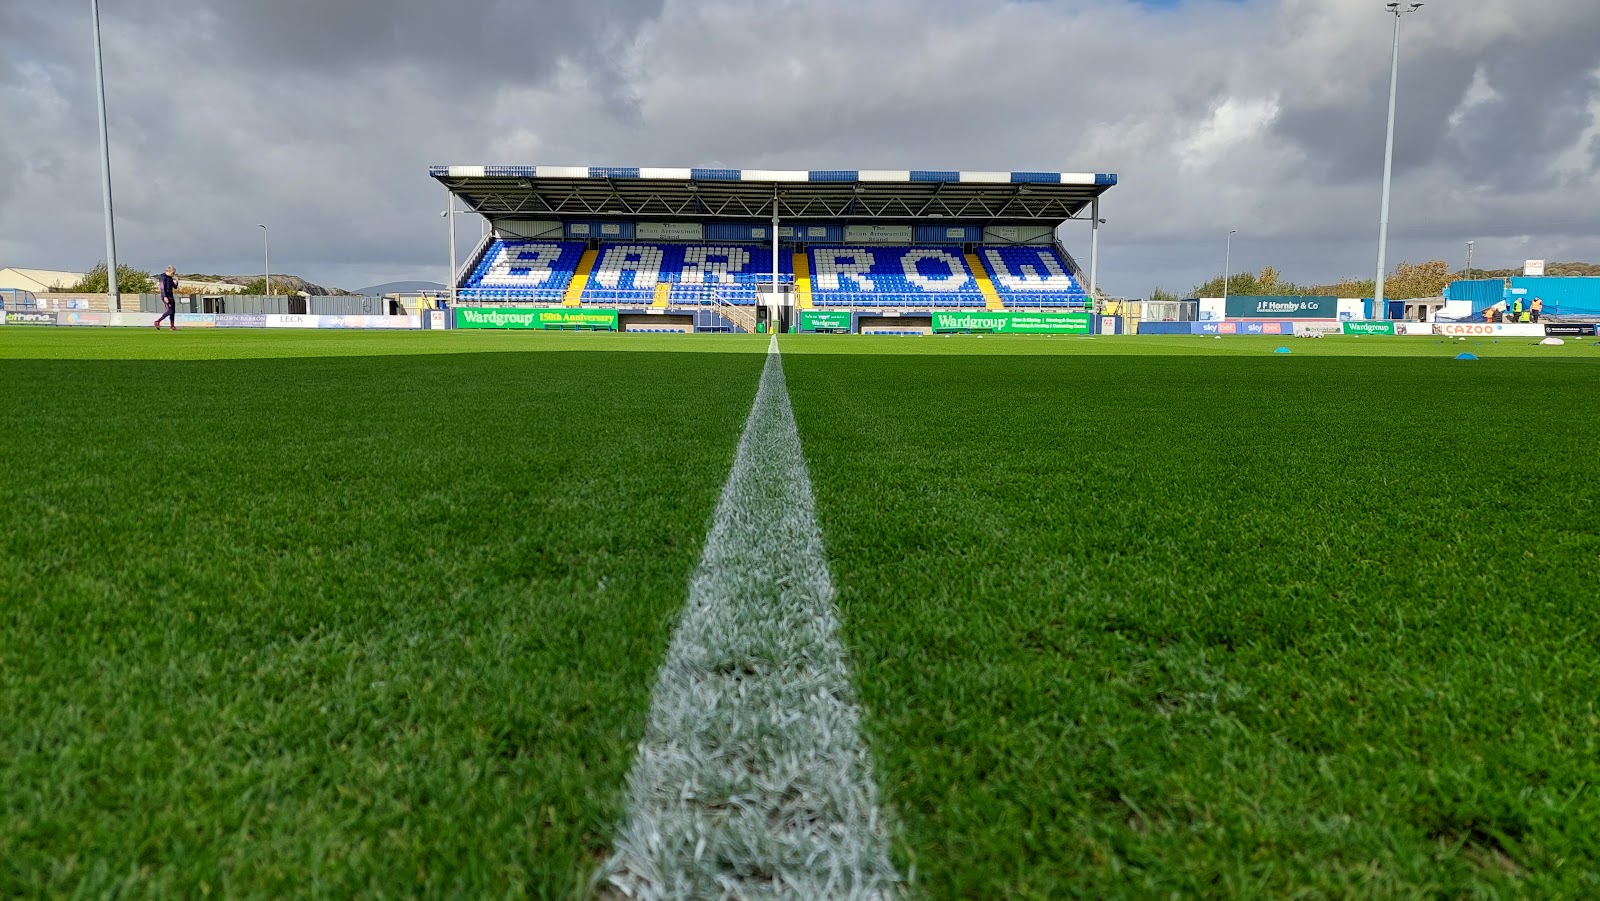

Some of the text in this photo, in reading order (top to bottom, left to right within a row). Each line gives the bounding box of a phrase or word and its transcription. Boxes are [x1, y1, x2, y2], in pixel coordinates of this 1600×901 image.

[1263, 301, 1268, 309] F
[1269, 301, 1299, 311] Hornby
[463, 311, 614, 326] Wardgroup 150th Anniversary
[811, 319, 840, 327] Wardgroup
[938, 315, 1007, 330] Wardgroup
[1203, 323, 1235, 331] sky bet
[1248, 323, 1280, 332] sky bet
[1348, 323, 1389, 332] Wardgroup
[1446, 325, 1493, 334] CAZOO
